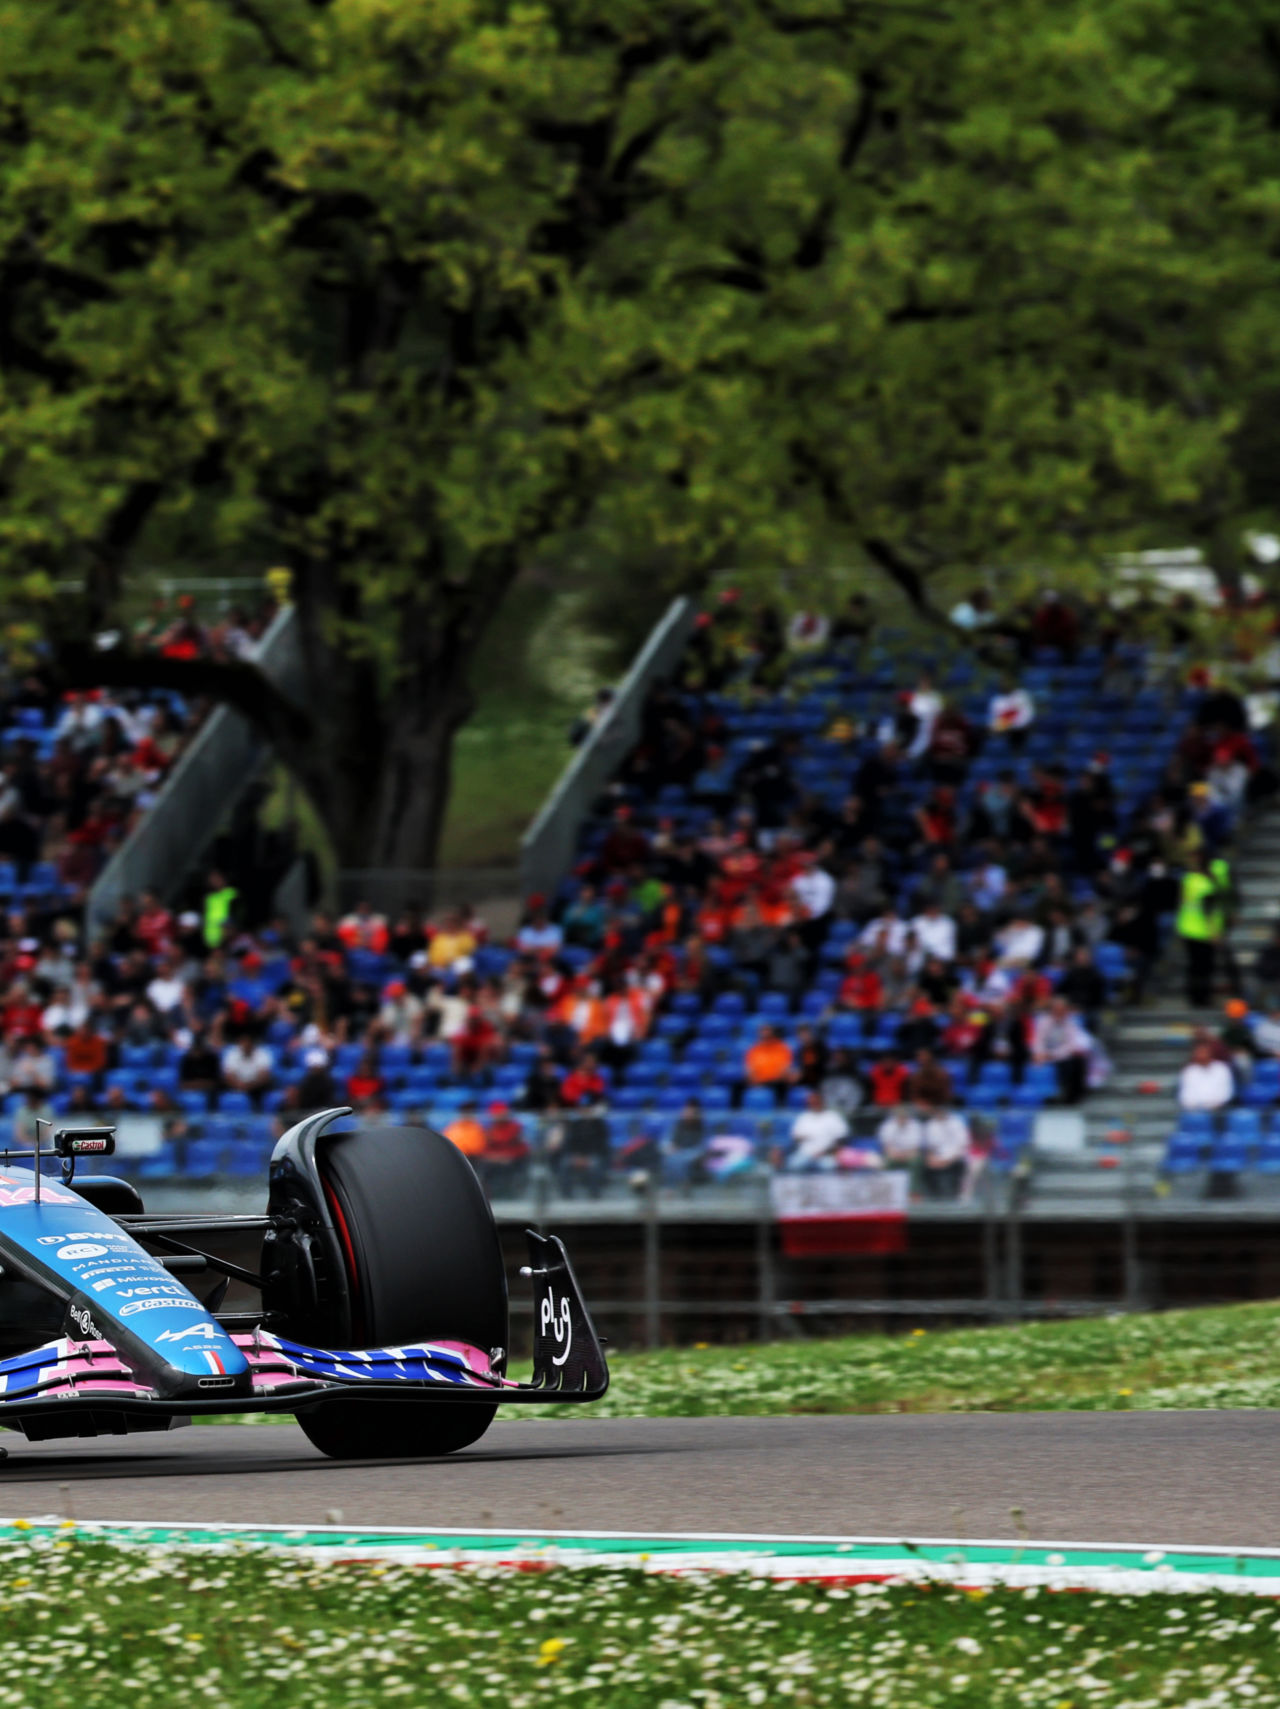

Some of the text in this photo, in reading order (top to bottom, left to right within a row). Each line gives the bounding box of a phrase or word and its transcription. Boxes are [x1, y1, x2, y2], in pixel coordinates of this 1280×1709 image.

[80, 1140, 105, 1151] Castrol
[115, 1285, 187, 1298] verti
[70, 1304, 82, 1324] Bell
[541, 1286, 572, 1366] plug
